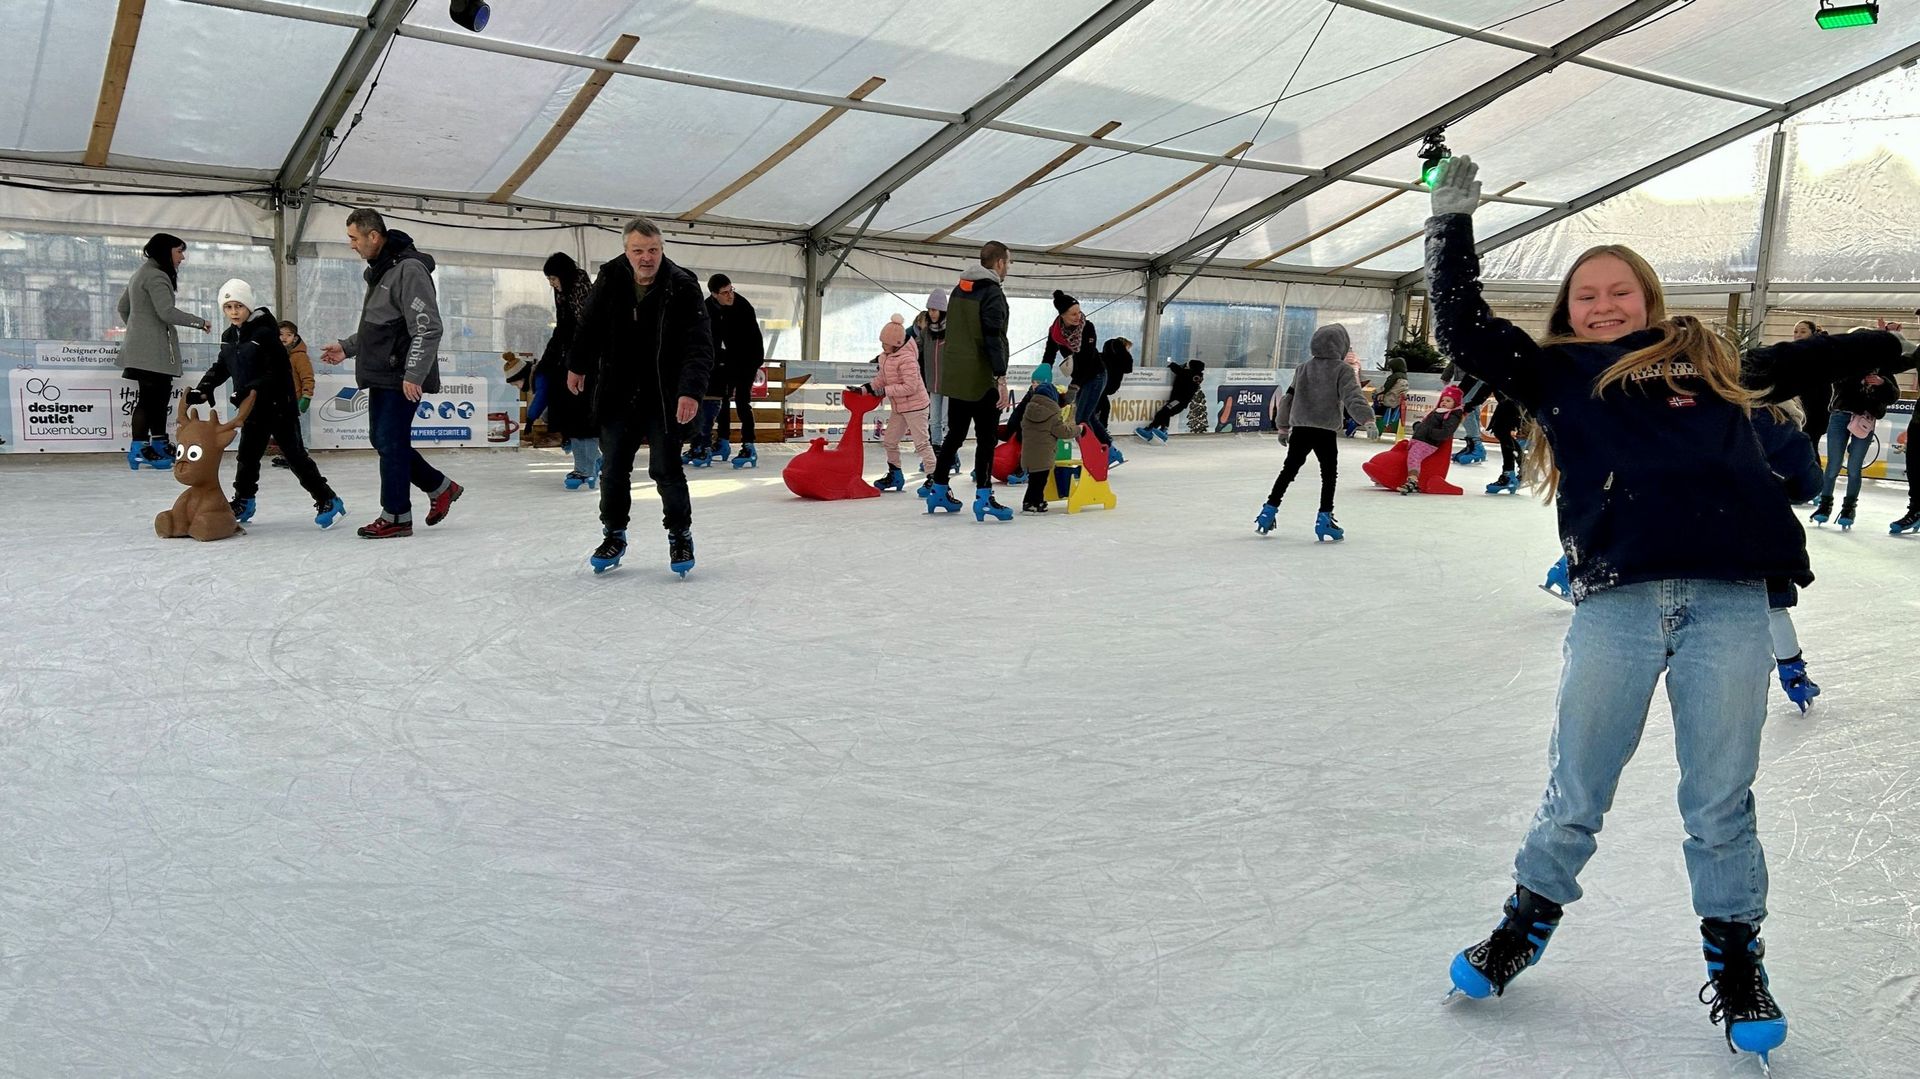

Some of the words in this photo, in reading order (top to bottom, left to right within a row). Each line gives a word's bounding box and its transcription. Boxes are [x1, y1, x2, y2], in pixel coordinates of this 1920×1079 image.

[62, 346, 97, 355] Designer
[98, 347, 120, 355] Outle
[1237, 391, 1263, 404] ARLON
[28, 402, 94, 415] designer
[29, 414, 75, 424] outlet
[29, 425, 107, 436] Luxembourg
